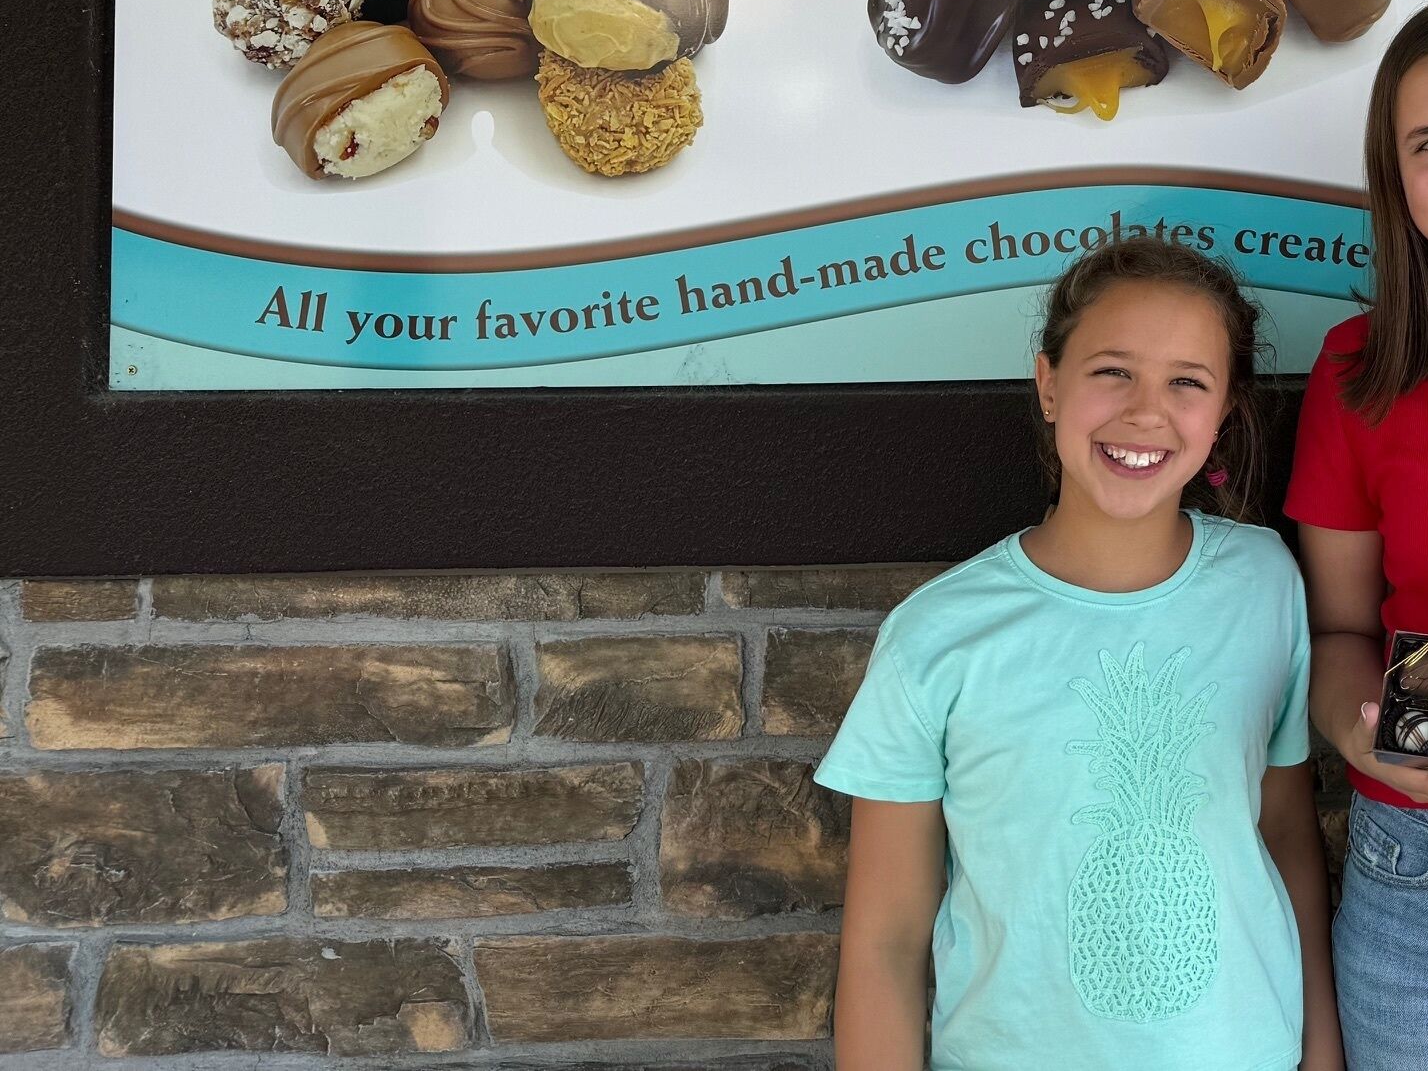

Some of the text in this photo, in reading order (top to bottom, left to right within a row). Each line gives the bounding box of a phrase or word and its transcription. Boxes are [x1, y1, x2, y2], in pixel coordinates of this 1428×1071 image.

[255, 285, 328, 333] All
[345, 308, 458, 345] your
[475, 289, 660, 340] favorite
[674, 234, 947, 316] hand-made
